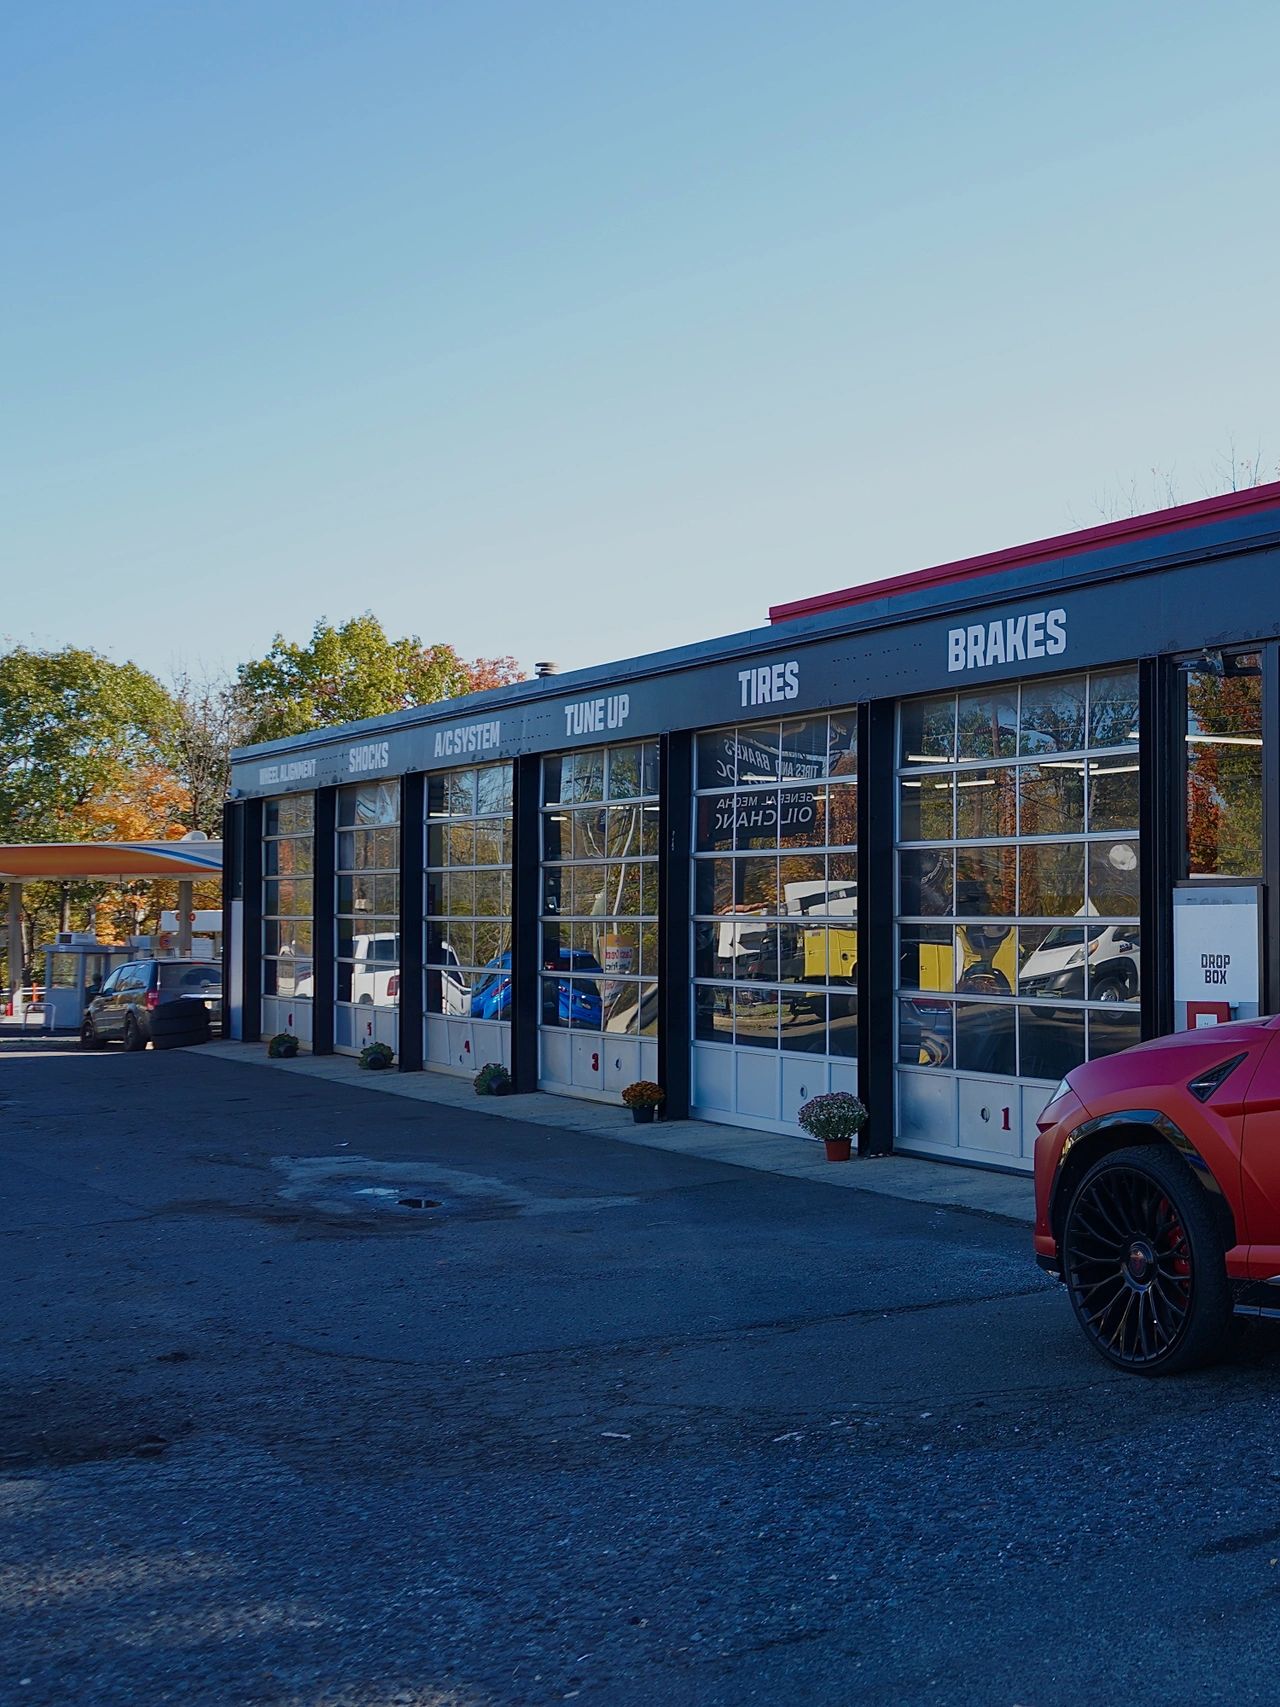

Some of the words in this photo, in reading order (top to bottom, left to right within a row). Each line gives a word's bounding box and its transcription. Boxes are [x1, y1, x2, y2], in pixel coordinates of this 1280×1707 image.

[948, 608, 1067, 673] BRAKES
[738, 660, 799, 707] TIRES
[565, 699, 605, 736] TUNE
[606, 694, 630, 729] UP
[434, 730, 453, 758] A/C
[452, 721, 500, 755] SYSTEM
[280, 759, 317, 782] ALIGNMENT
[348, 742, 389, 773] SHOCKS
[1201, 953, 1231, 969] DROP
[1204, 969, 1227, 985] BOX
[592, 1052, 599, 1072] 3
[1001, 1106, 1011, 1131] 1
